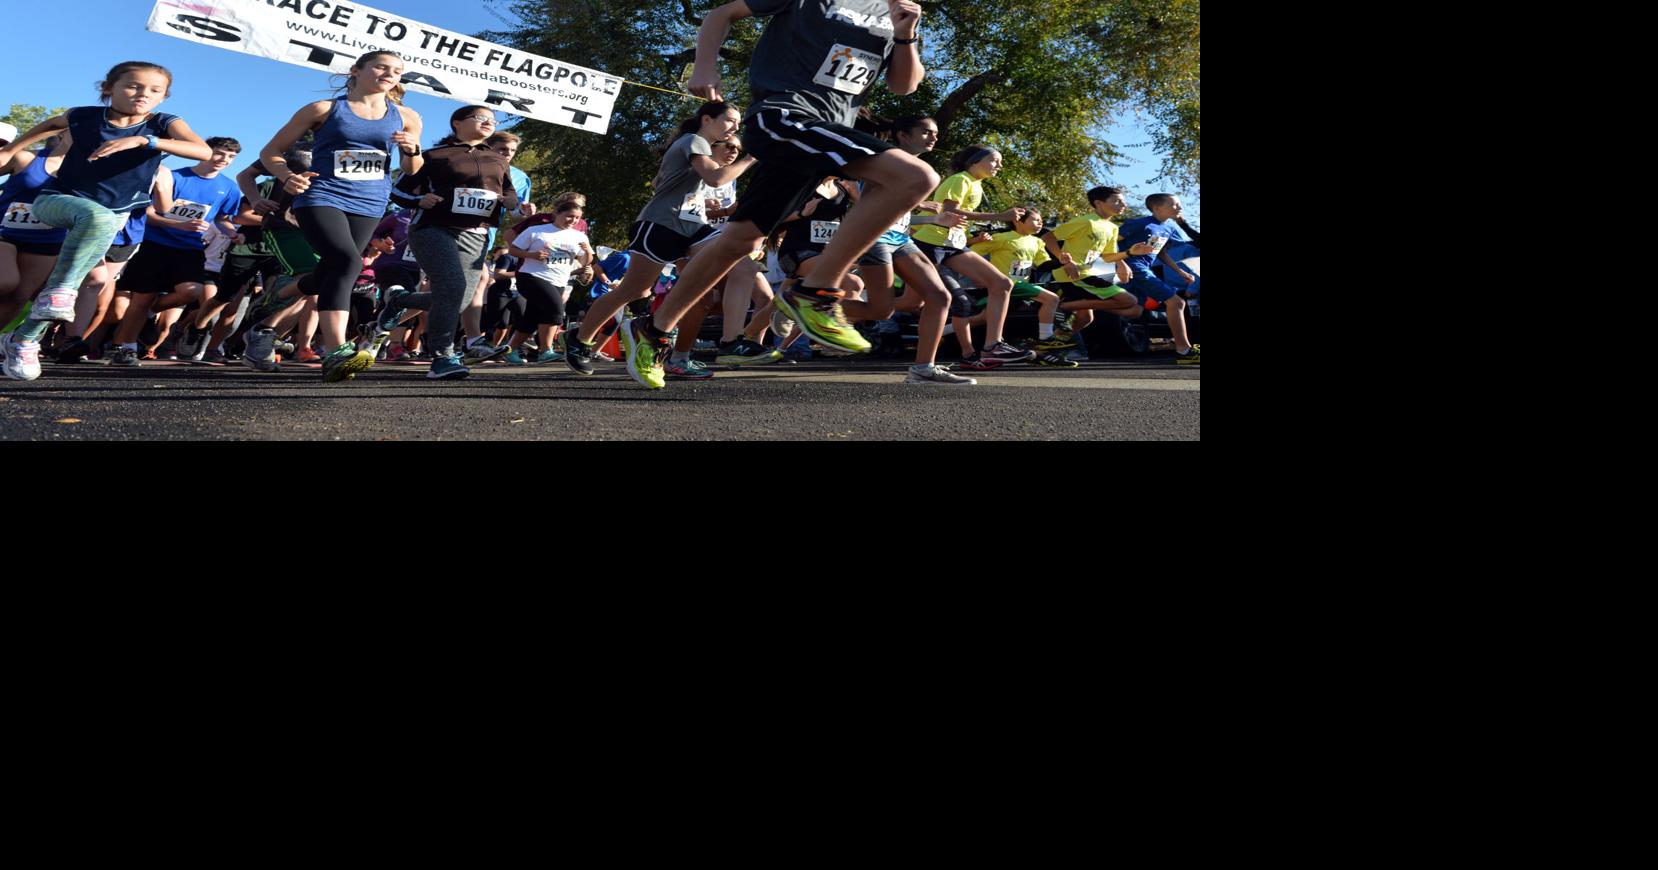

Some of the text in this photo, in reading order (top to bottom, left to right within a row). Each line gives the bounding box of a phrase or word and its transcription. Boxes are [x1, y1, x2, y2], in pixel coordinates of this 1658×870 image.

[257, 0, 354, 28] ACE
[366, 14, 407, 41] TO
[420, 29, 479, 61] THE
[286, 20, 588, 105] www.LiveoreGranadaBoosters.org
[824, 59, 876, 86] 1129
[339, 159, 381, 174] 1206
[170, 205, 204, 220] 1024
[457, 195, 494, 211] 1062
